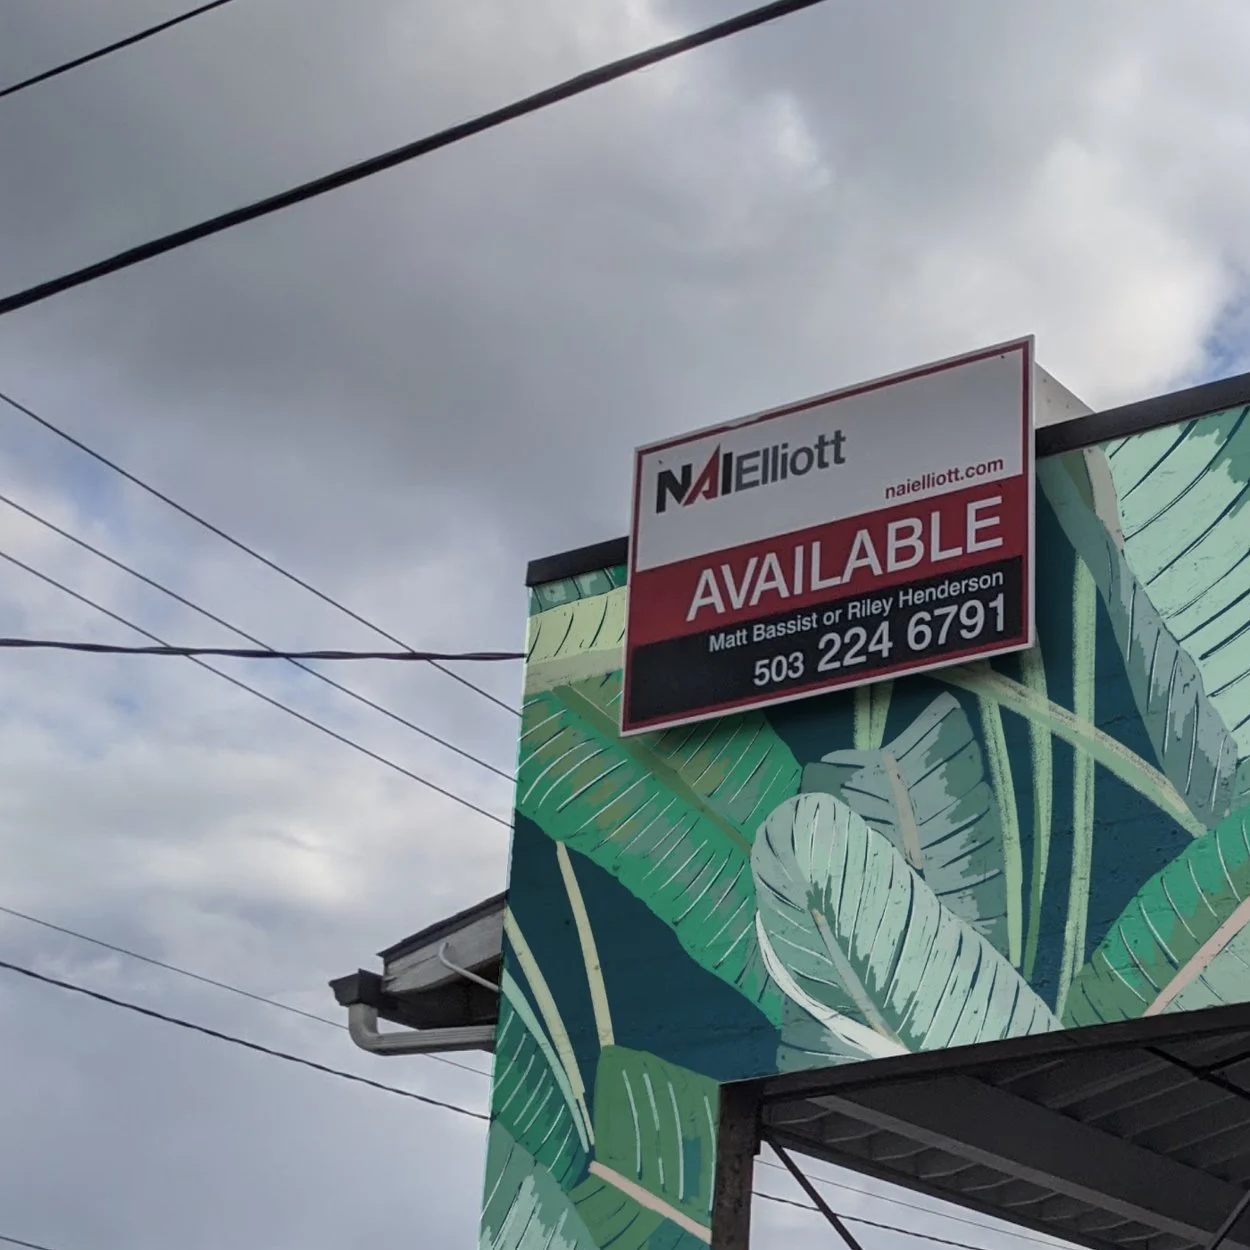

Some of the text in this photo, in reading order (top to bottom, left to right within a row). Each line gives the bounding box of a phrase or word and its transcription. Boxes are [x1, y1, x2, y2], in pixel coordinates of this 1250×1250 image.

[885, 458, 1004, 500] naielliott.com
[686, 496, 1003, 622] AVAILABLE
[709, 571, 1004, 653] Matt Bassist or Riley Henderson
[753, 593, 1005, 687] 503 224 6791
